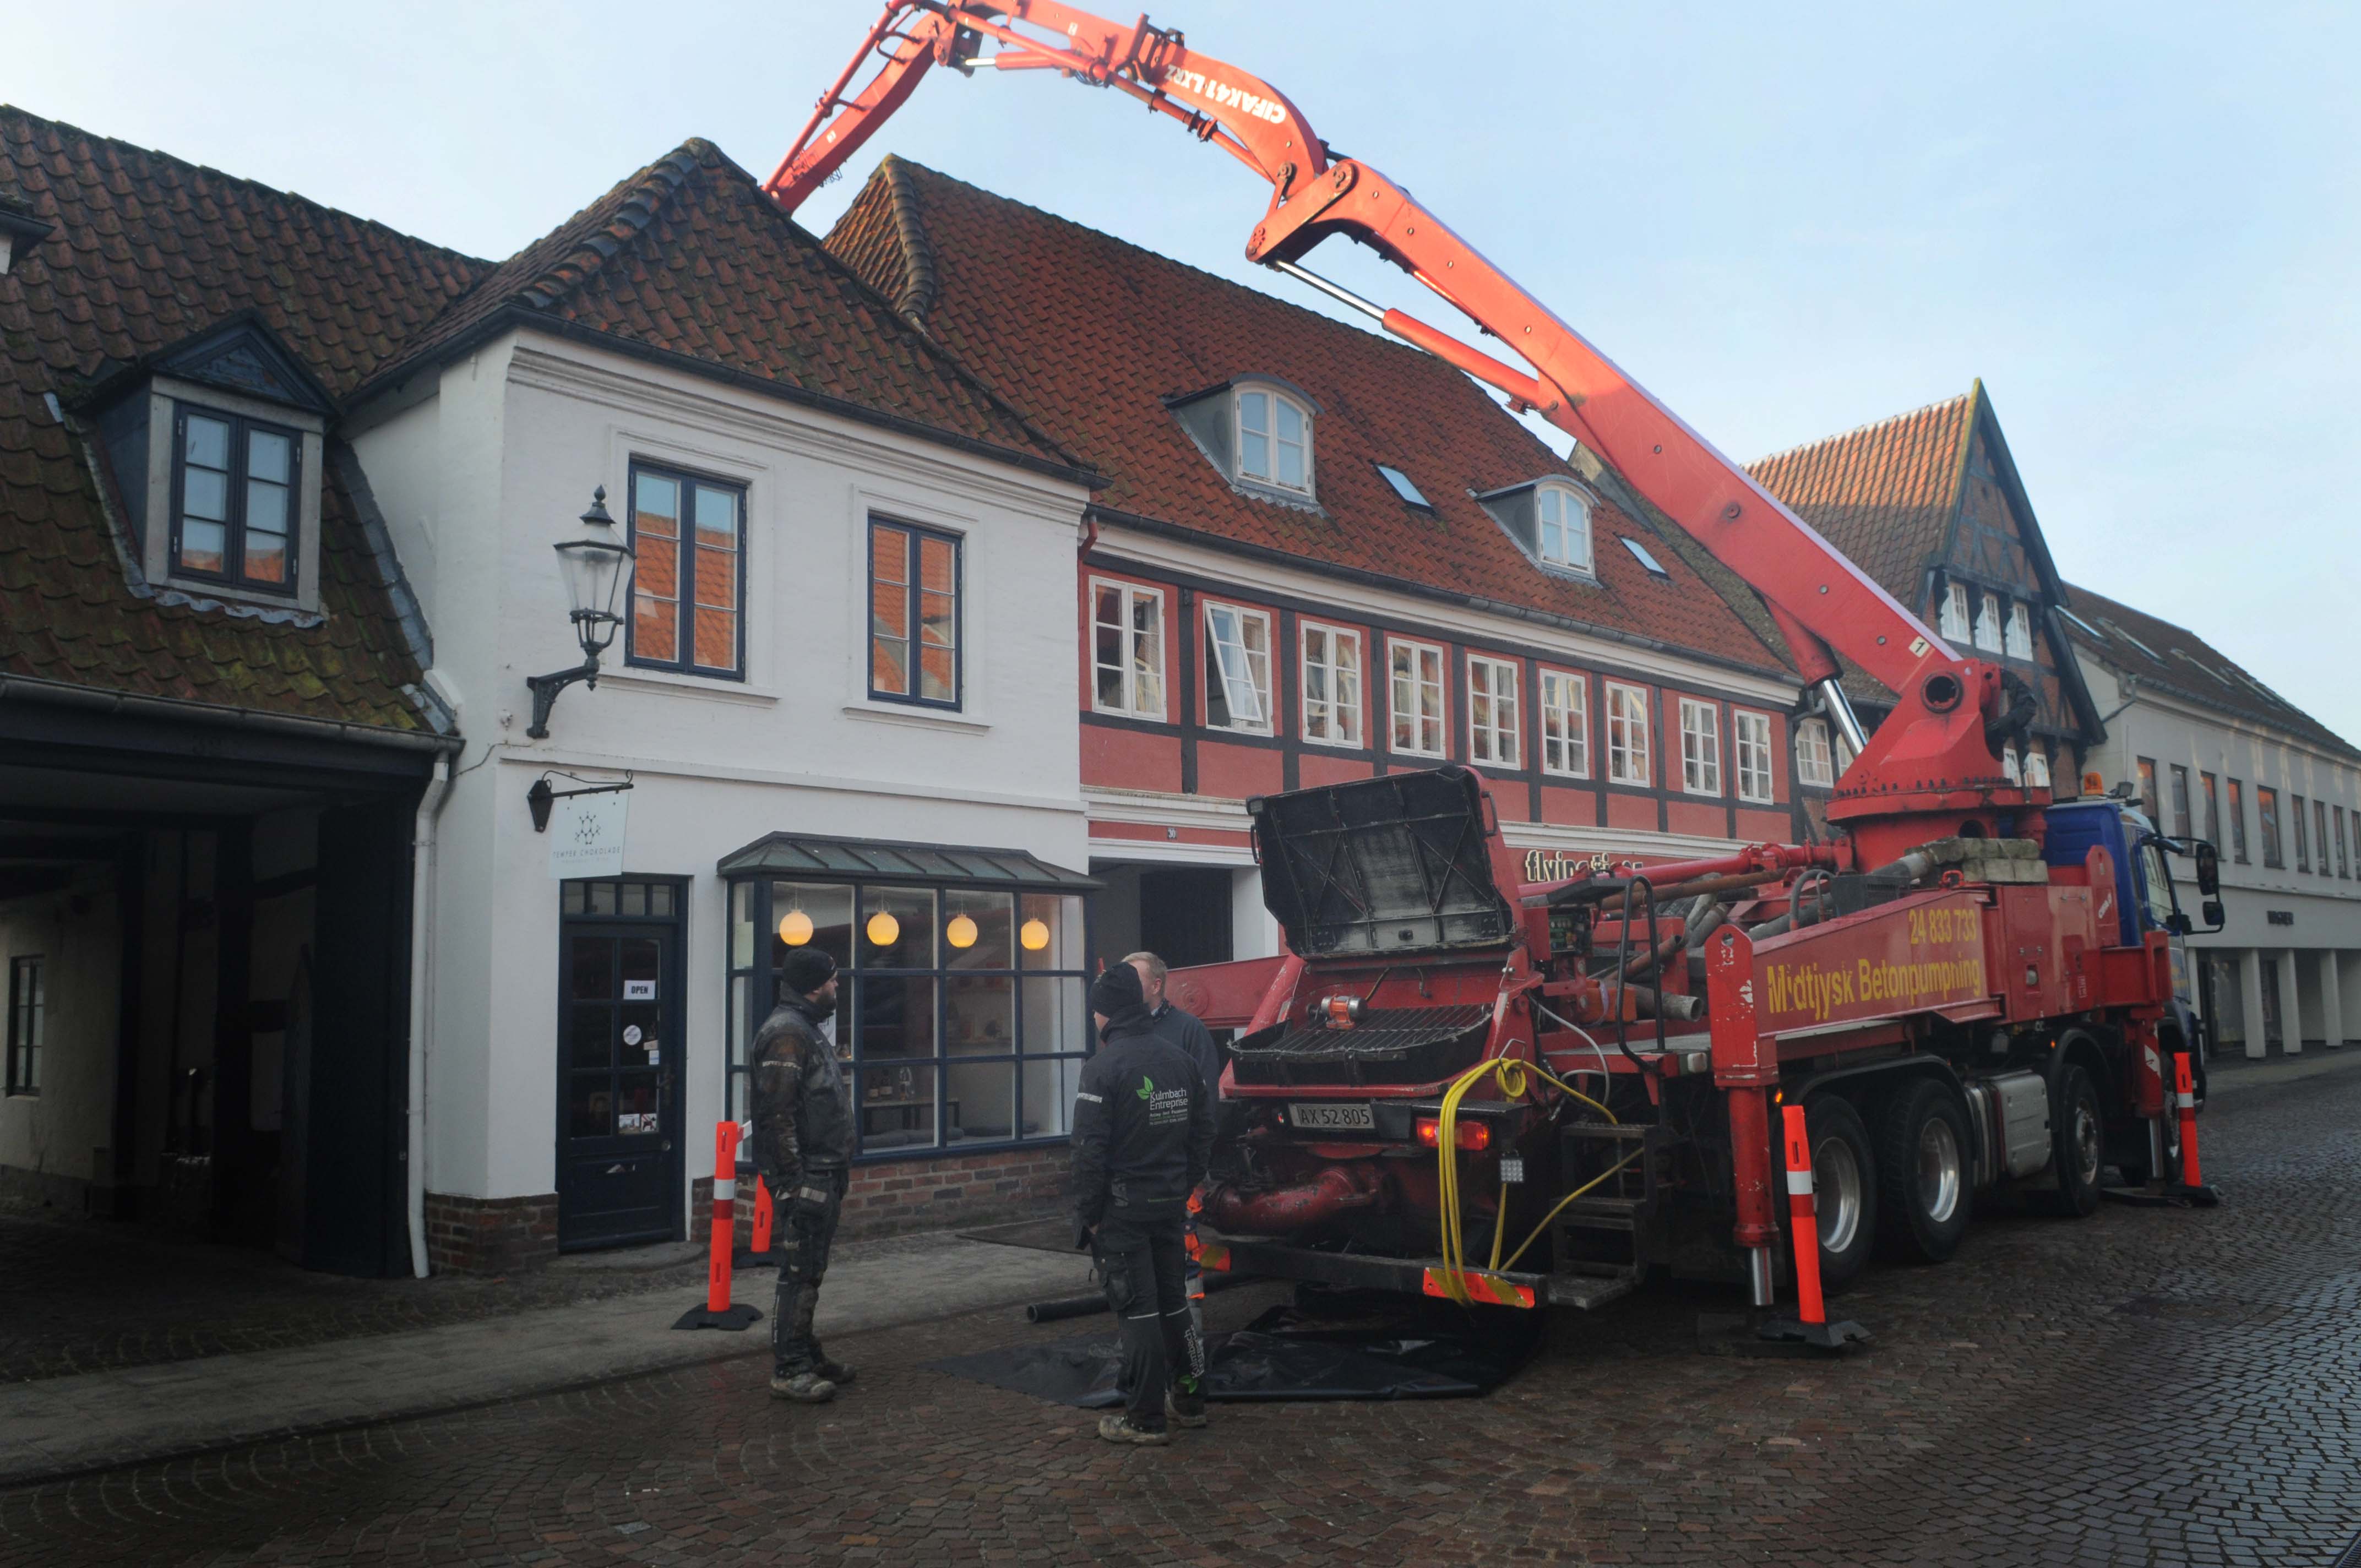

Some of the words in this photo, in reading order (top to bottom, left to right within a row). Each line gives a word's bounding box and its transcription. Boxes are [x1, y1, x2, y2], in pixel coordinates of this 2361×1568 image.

[1915, 641, 1925, 653] 1
[1908, 909, 1927, 945] 24
[1928, 908, 1952, 944] 833
[1953, 909, 1977, 943] 733
[631, 986, 649, 994] OPEN
[1767, 962, 1855, 1021] Midtjysk
[1858, 951, 1981, 1006] Betonpumpning
[1150, 1087, 1187, 1102] Kulmbach
[1149, 1098, 1189, 1110] Entreprise
[1301, 1108, 1320, 1124] AX
[1321, 1109, 1340, 1125] 52
[1342, 1108, 1370, 1125] 805
